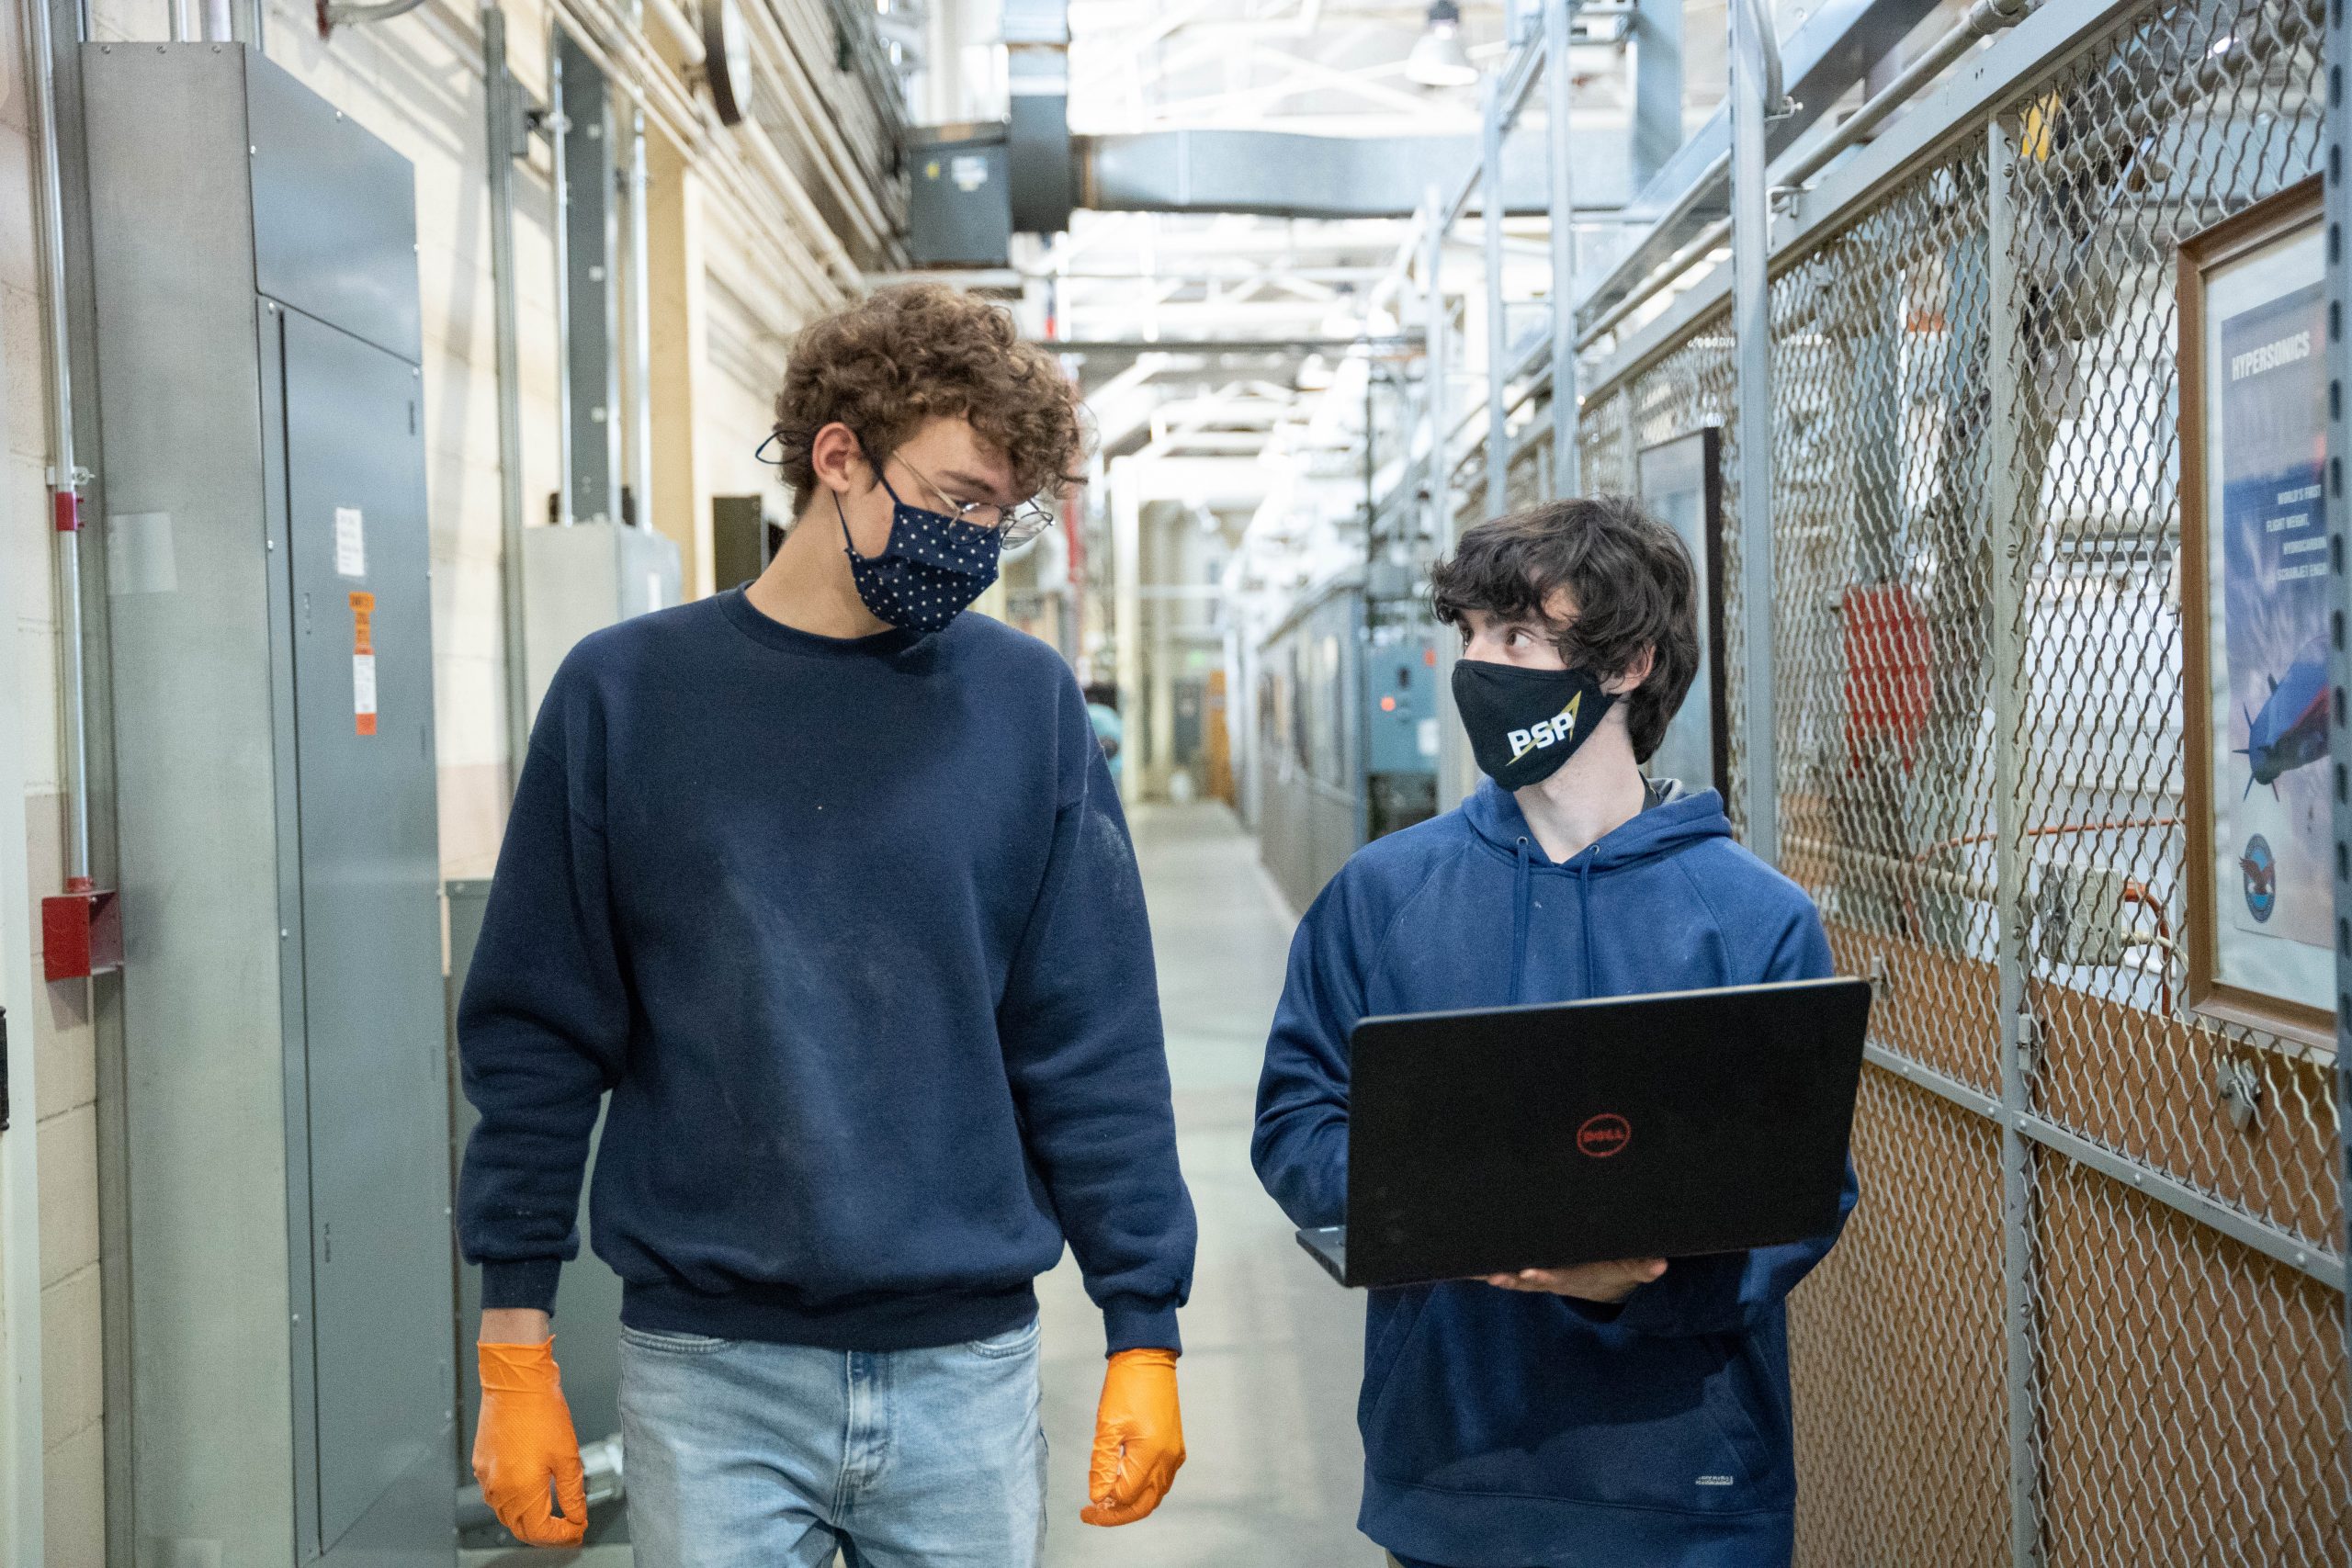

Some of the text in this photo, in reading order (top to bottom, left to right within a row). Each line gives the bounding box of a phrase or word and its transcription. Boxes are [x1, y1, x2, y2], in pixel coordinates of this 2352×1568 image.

[2232, 331, 2310, 381] HYPERSONICS
[2278, 484, 2322, 505] WORLD'S FIRST
[2266, 517, 2286, 533] FLIGHT
[2278, 566, 2309, 581] SCRAMJET
[1507, 712, 1574, 759] PSP
[1583, 1129, 1624, 1143] DELL
